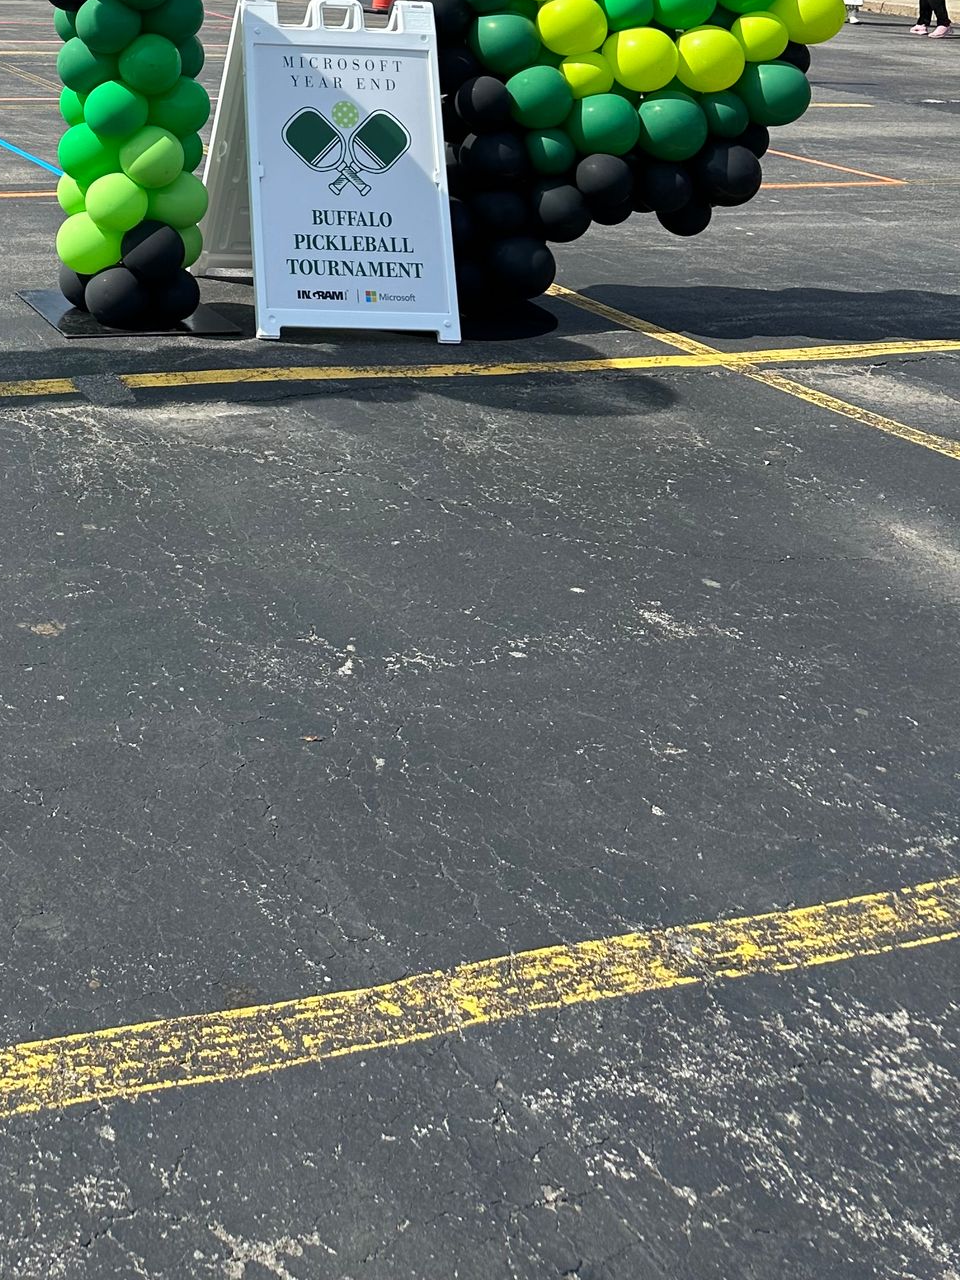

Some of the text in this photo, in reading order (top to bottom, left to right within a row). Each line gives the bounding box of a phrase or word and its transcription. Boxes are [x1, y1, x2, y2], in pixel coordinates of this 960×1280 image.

[282, 55, 402, 72] MICROSOFT
[290, 75, 396, 91] YEAR END
[311, 209, 393, 228] BUFFALO
[294, 233, 414, 253] PICKLEBALL
[286, 258, 424, 278] TOURNAMENT
[378, 293, 416, 302] Microsoft
